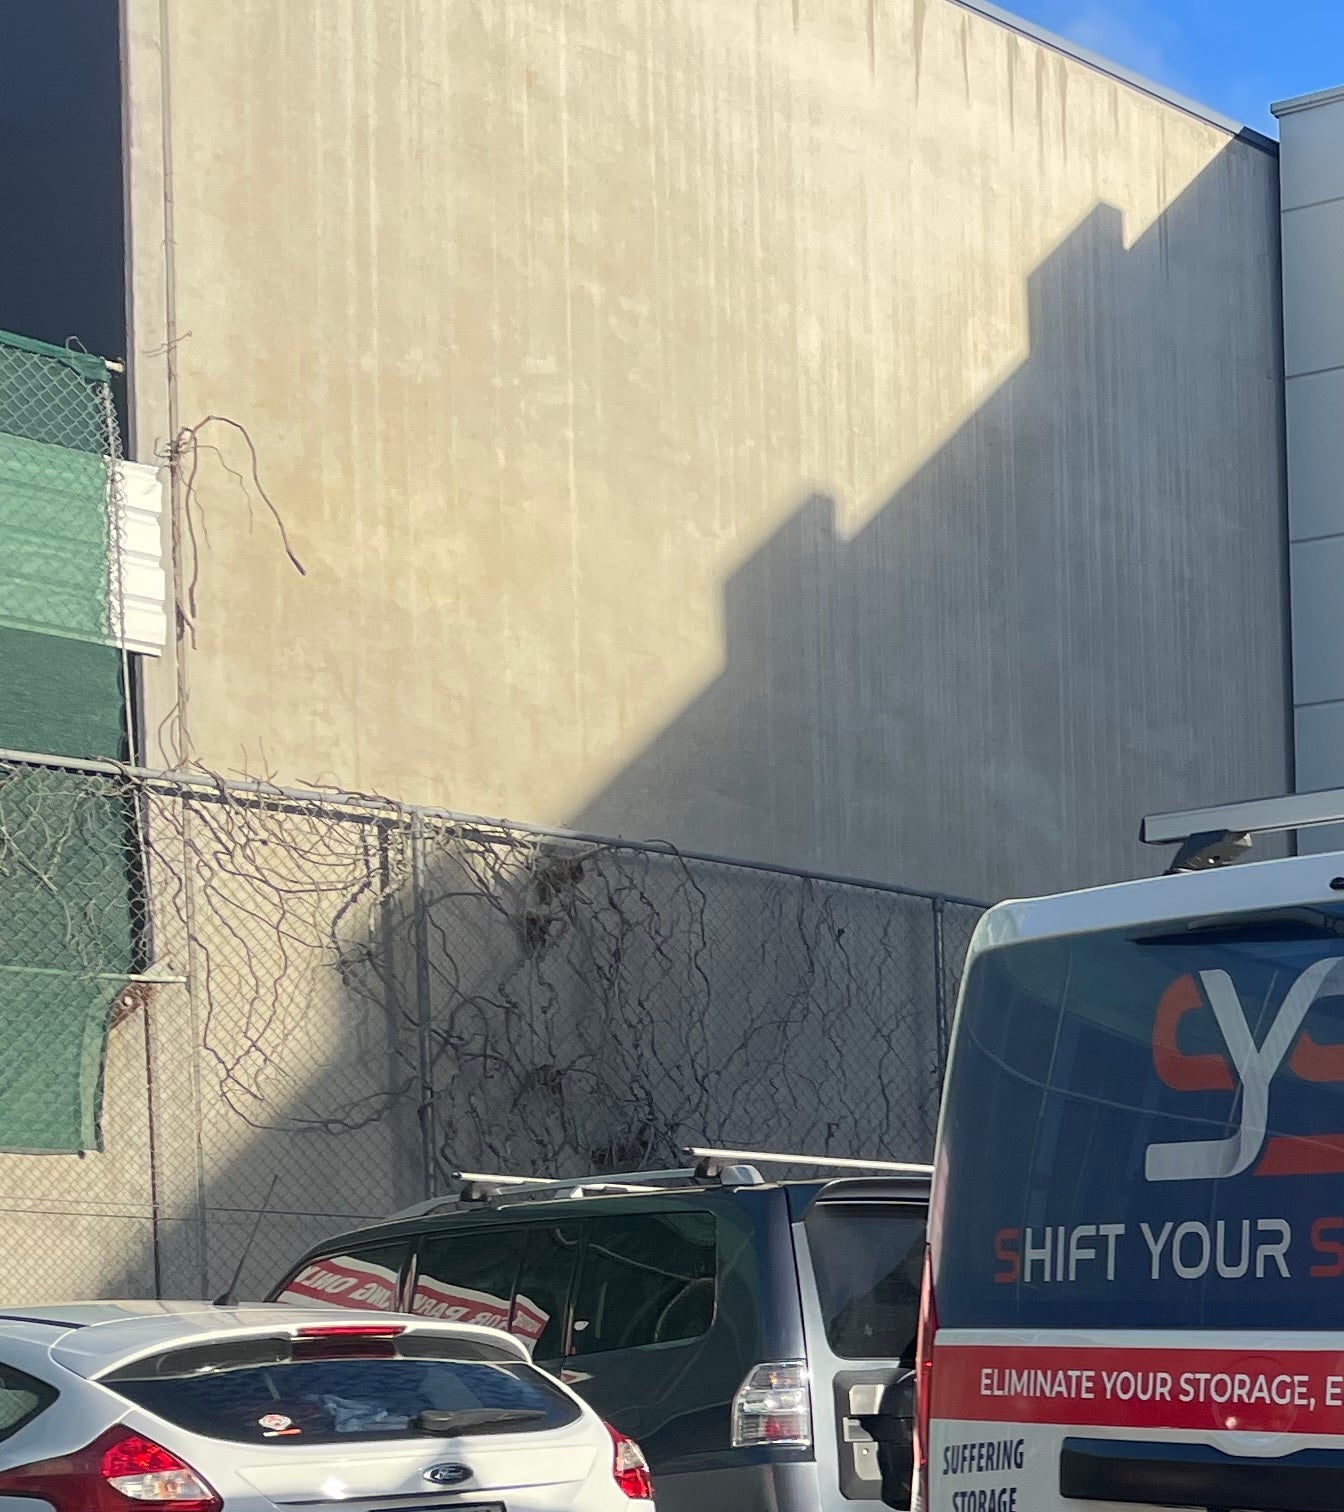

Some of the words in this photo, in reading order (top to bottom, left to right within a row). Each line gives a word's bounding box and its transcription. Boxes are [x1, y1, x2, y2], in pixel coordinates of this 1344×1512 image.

[993, 1222, 1125, 1283] SHIFT
[1139, 1218, 1291, 1280] YOUR
[980, 1368, 1096, 1399] ELIMINATE
[1102, 1371, 1172, 1401] YOUR
[1180, 1373, 1316, 1411] STORAGE,
[943, 1439, 1025, 1475] SUFFERING
